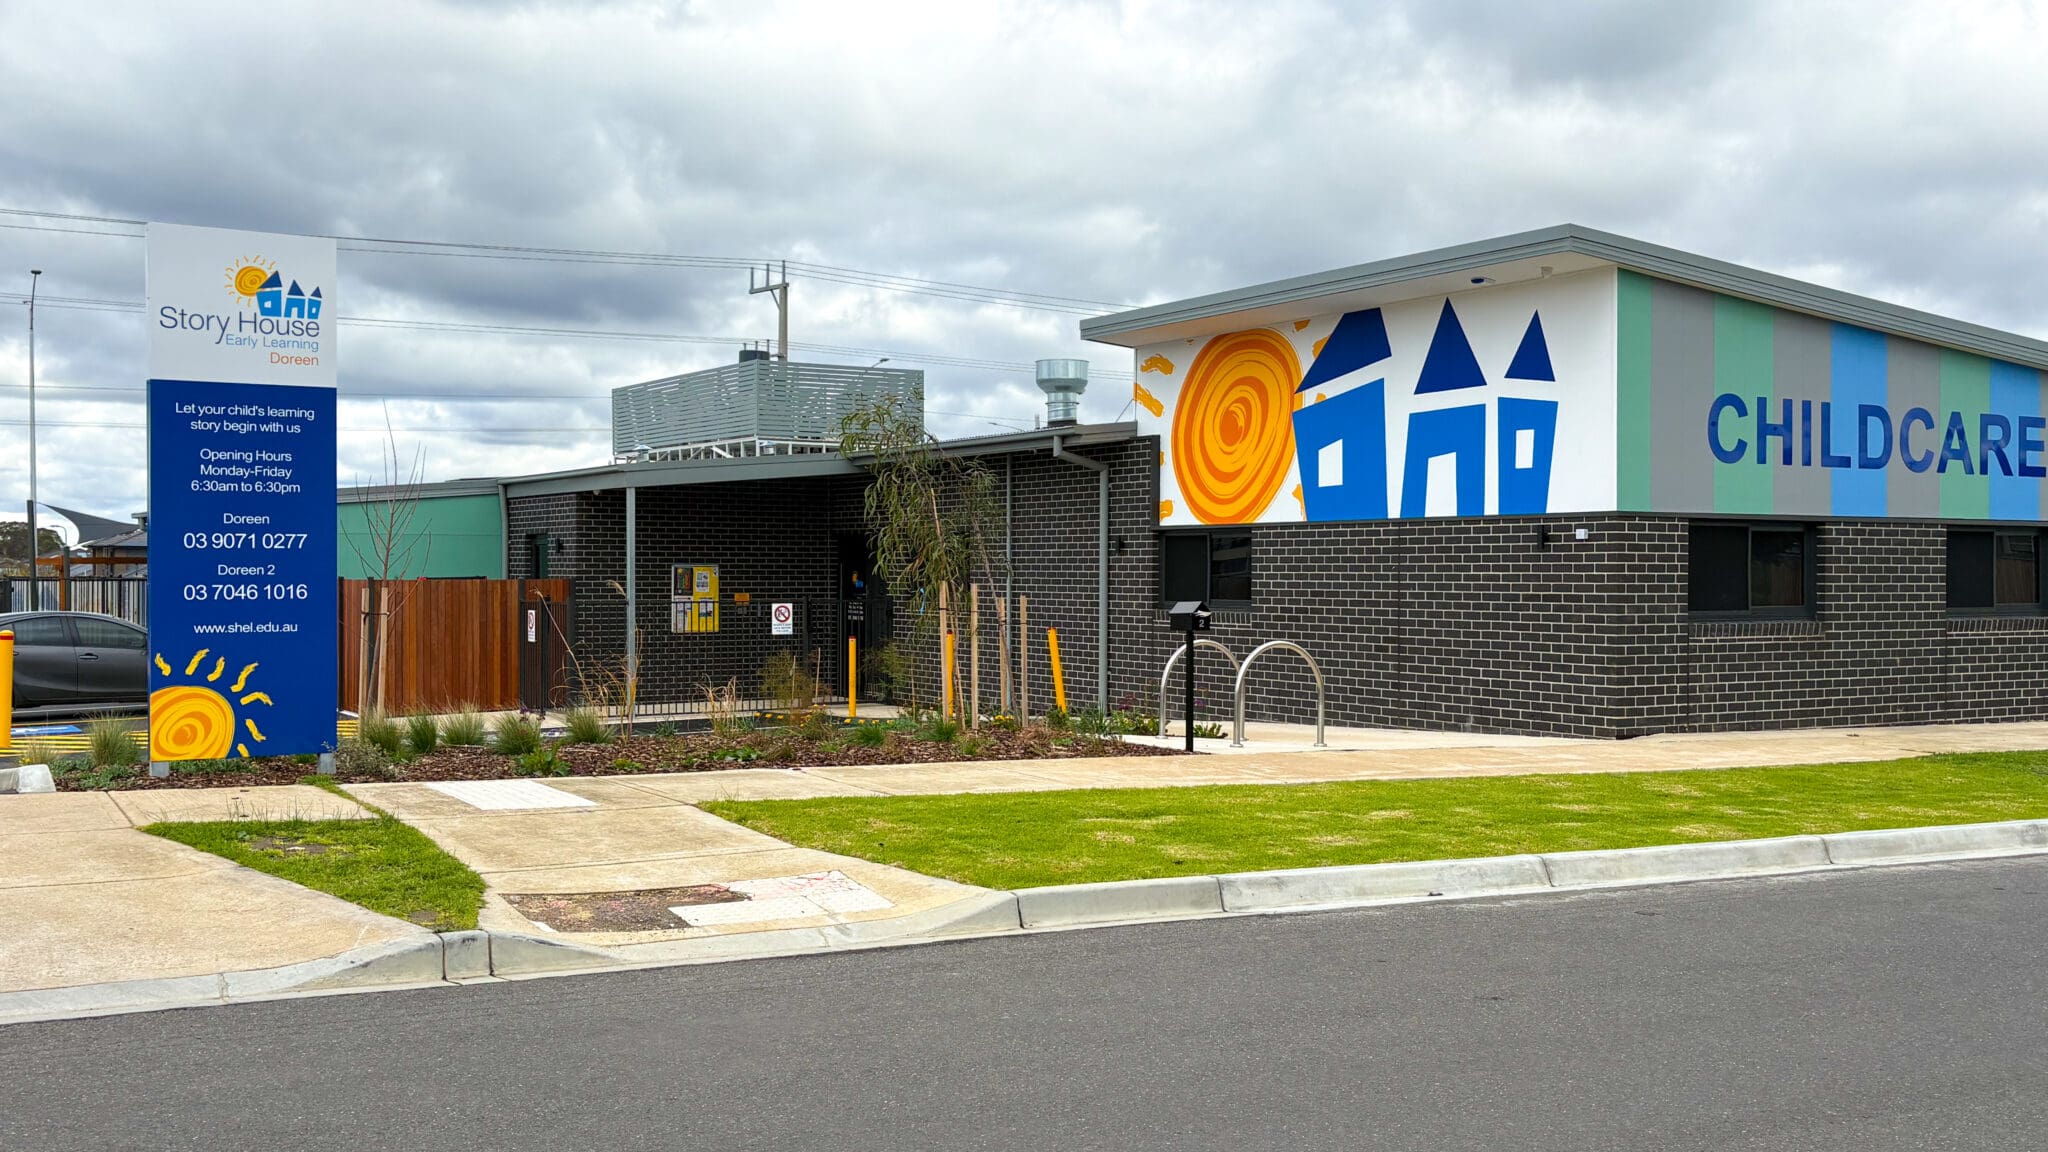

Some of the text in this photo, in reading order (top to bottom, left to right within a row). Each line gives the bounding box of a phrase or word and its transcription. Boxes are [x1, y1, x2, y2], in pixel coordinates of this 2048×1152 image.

[160, 306, 320, 344] Story House
[226, 334, 319, 352] Early Learning
[270, 352, 319, 366] Doreen
[175, 402, 315, 421] Let your child's learning
[190, 420, 301, 434] story begin with us
[1707, 393, 2047, 478] CHILDCARE
[200, 448, 292, 463] Opening Hours
[200, 464, 292, 480] Monday-Friday
[190, 480, 301, 495] 6:30am to 6:30pm
[223, 512, 270, 525] Doreen
[183, 532, 308, 549] 03 9071 0277
[217, 564, 276, 576] Doreen 2
[183, 584, 308, 601] 03 7046 1016
[193, 621, 298, 634] www.shel.edu.au
[1198, 619, 1205, 628] 2
